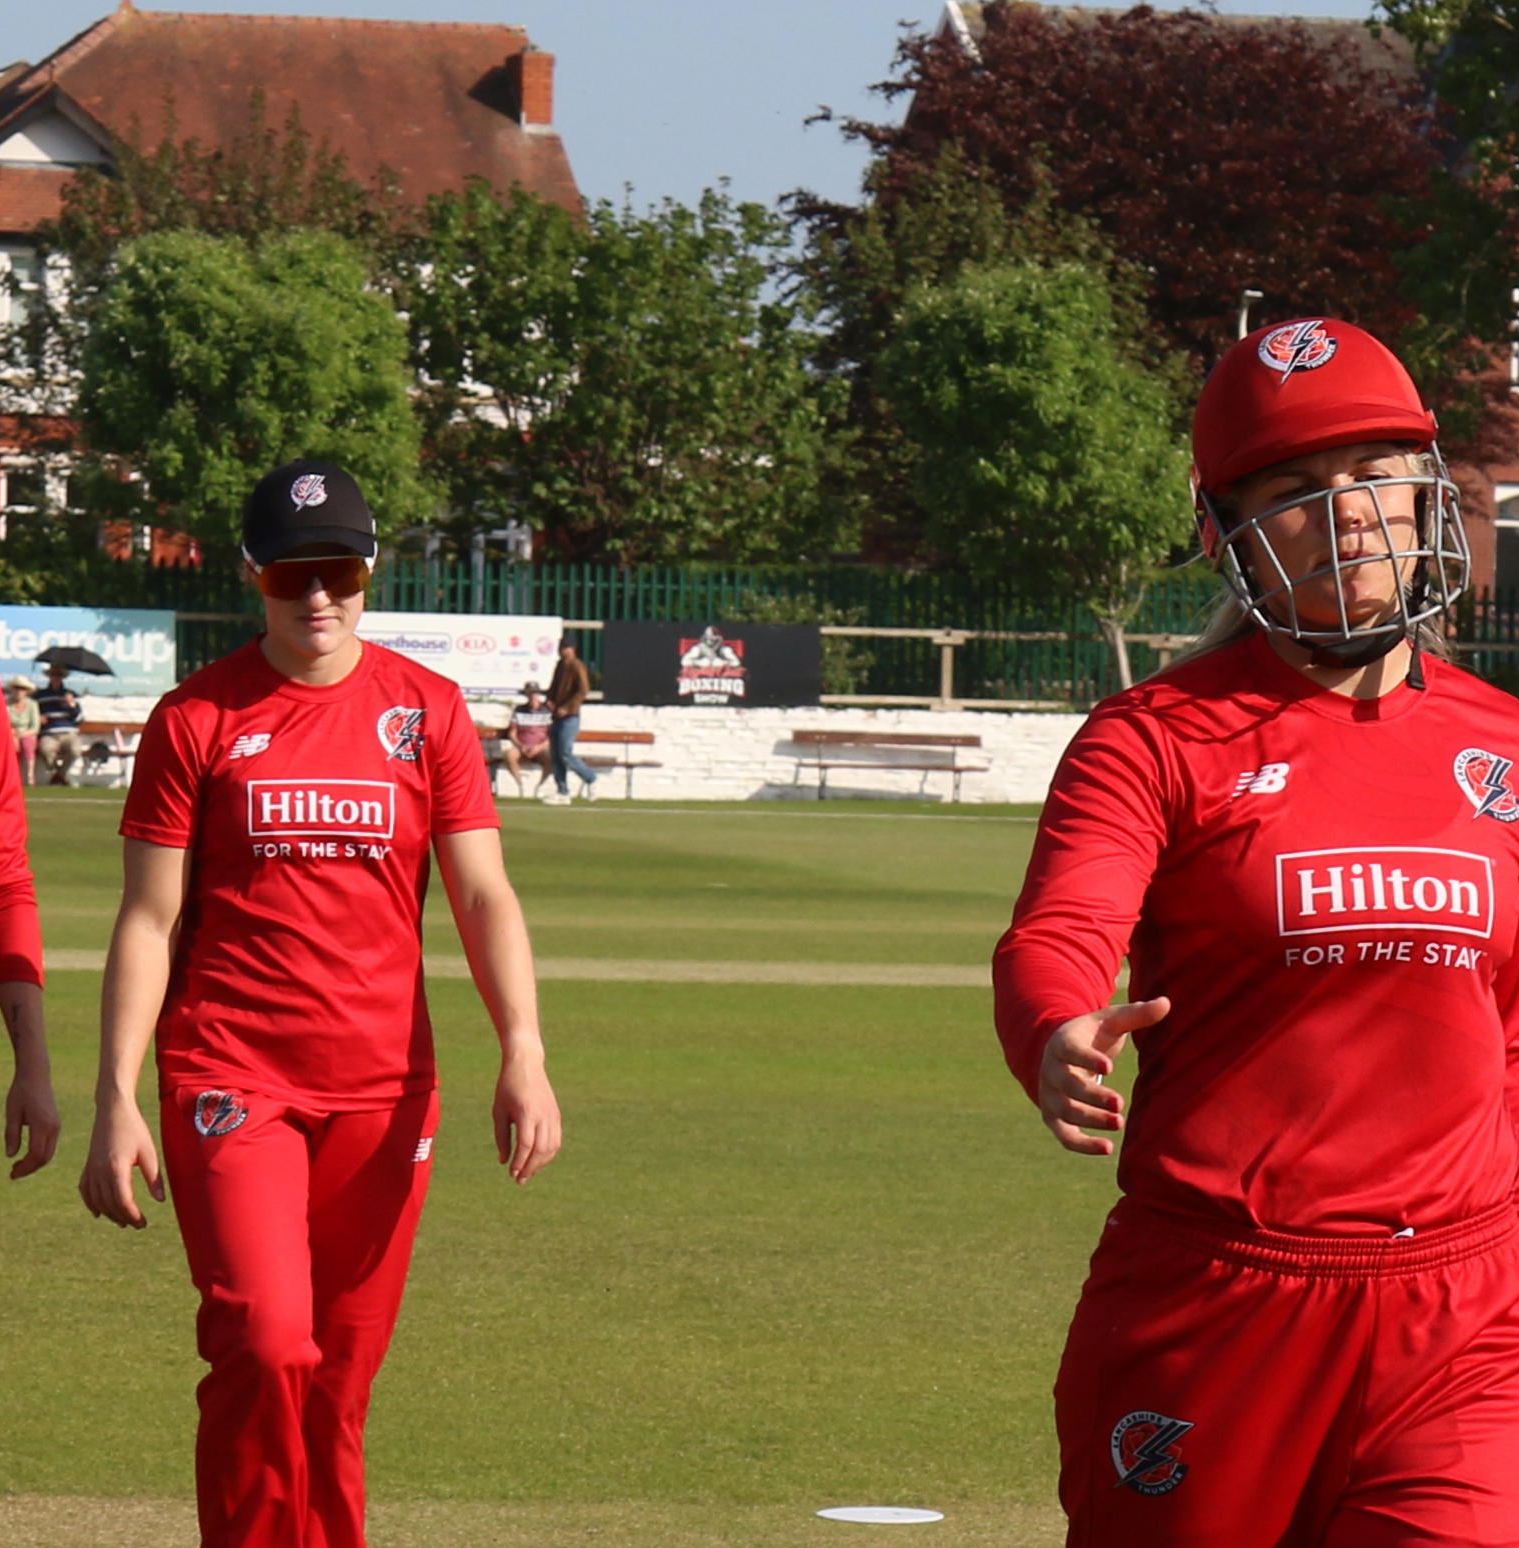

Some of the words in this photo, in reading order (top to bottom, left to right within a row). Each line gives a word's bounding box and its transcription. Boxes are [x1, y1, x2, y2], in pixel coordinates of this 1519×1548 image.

[463, 639, 489, 650] KIA
[678, 677, 745, 697] BOXING
[260, 790, 383, 826] Hilton
[252, 843, 292, 858] FOR
[298, 842, 338, 858] THE
[344, 843, 390, 860] STAY
[1297, 863, 1481, 918] Hilton
[1285, 944, 1345, 968] FOR
[1357, 941, 1414, 962] THE
[1423, 942, 1483, 970] STAY
[1112, 1413, 1164, 1449] LANCASHIRE
[1138, 1472, 1183, 1495] THUNDER
